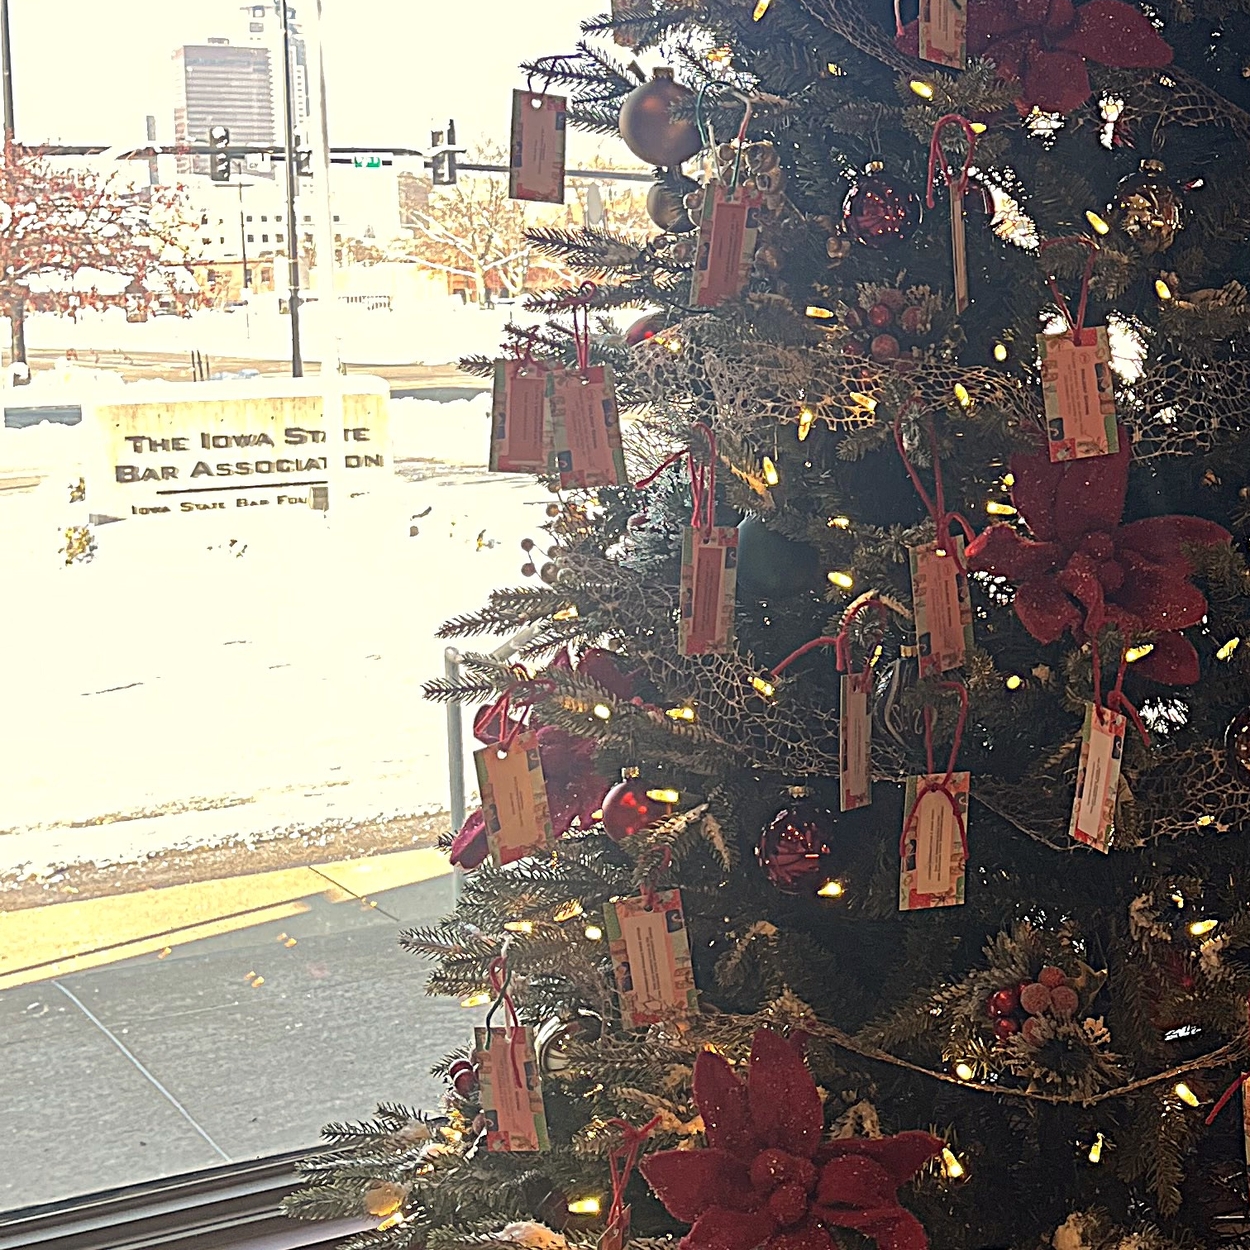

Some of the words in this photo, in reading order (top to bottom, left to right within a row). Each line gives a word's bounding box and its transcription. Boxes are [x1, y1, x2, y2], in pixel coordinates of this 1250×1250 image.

[125, 435, 190, 453] THE
[200, 432, 275, 450] IOWA
[115, 464, 179, 483] BAR
